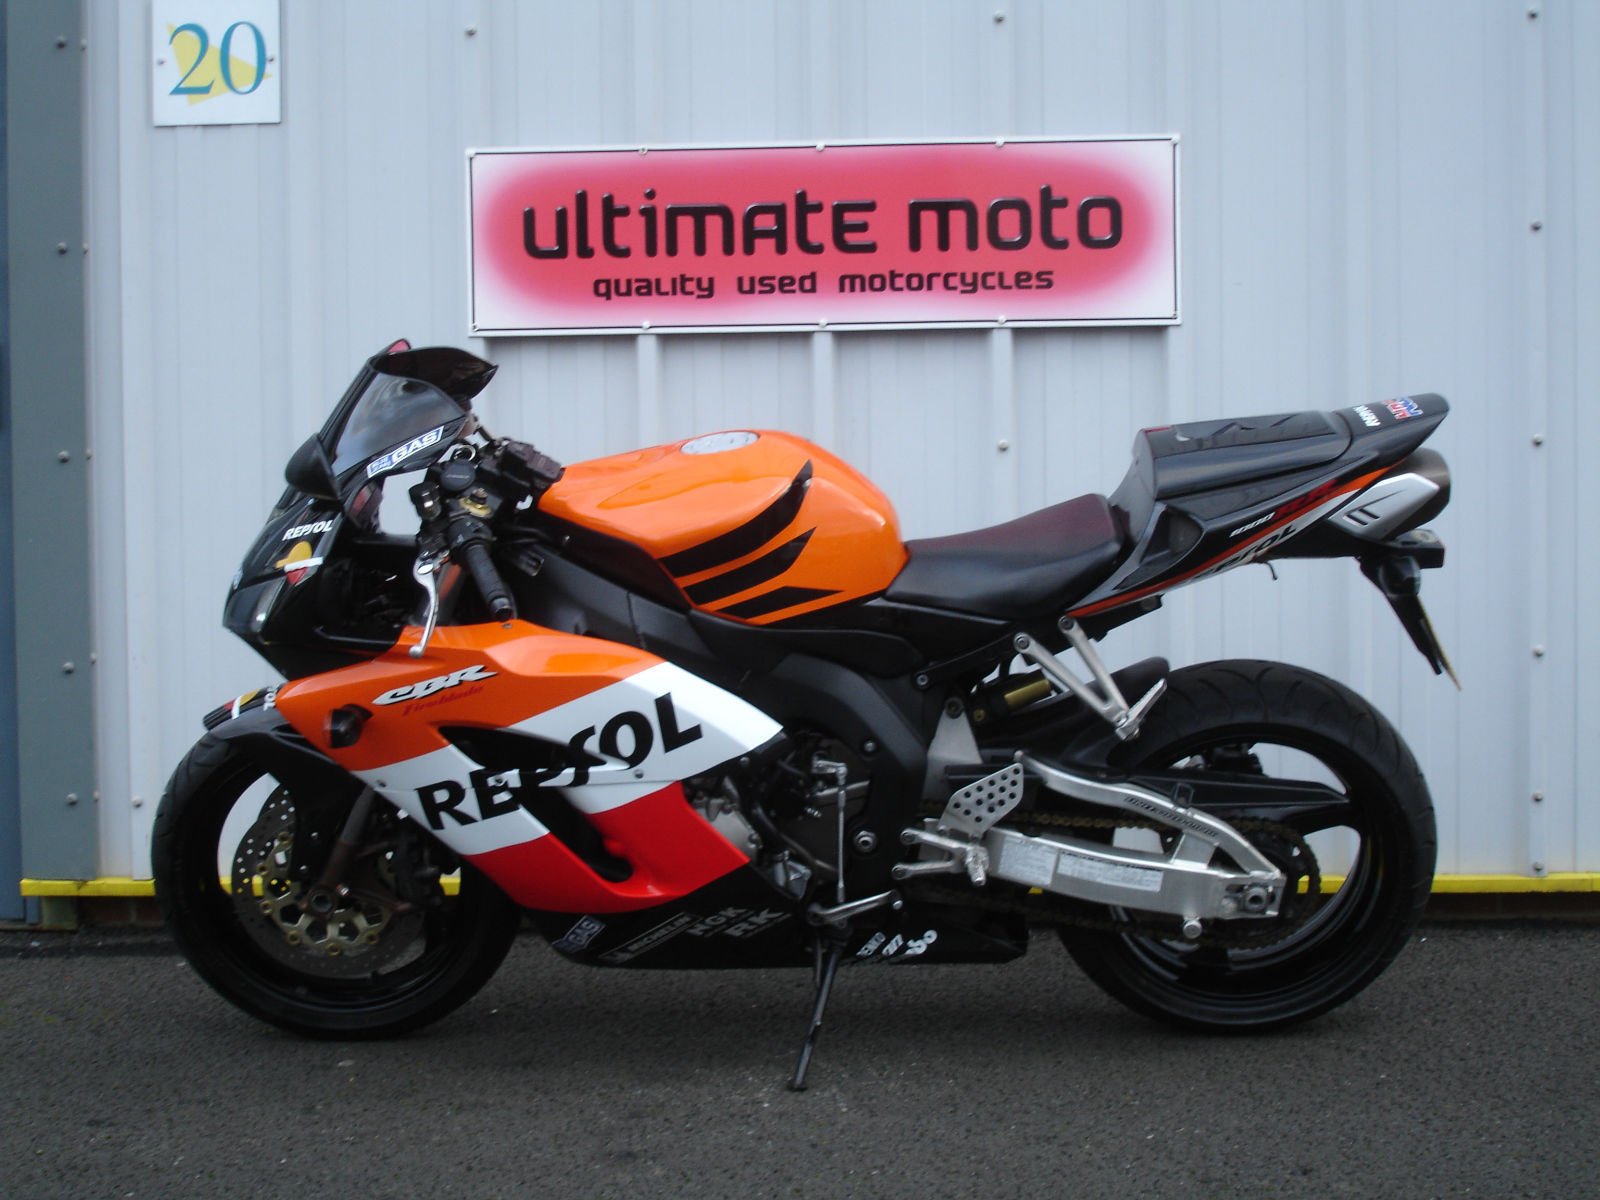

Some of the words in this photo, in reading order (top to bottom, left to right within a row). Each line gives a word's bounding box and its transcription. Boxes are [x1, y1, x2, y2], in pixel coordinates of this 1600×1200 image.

[169, 21, 267, 96] 20
[908, 184, 1123, 252] moto
[593, 274, 715, 300] quality
[737, 272, 817, 294] used
[838, 270, 1054, 294] motorcycles
[390, 429, 439, 461] GAS
[282, 519, 333, 541] REPSOL
